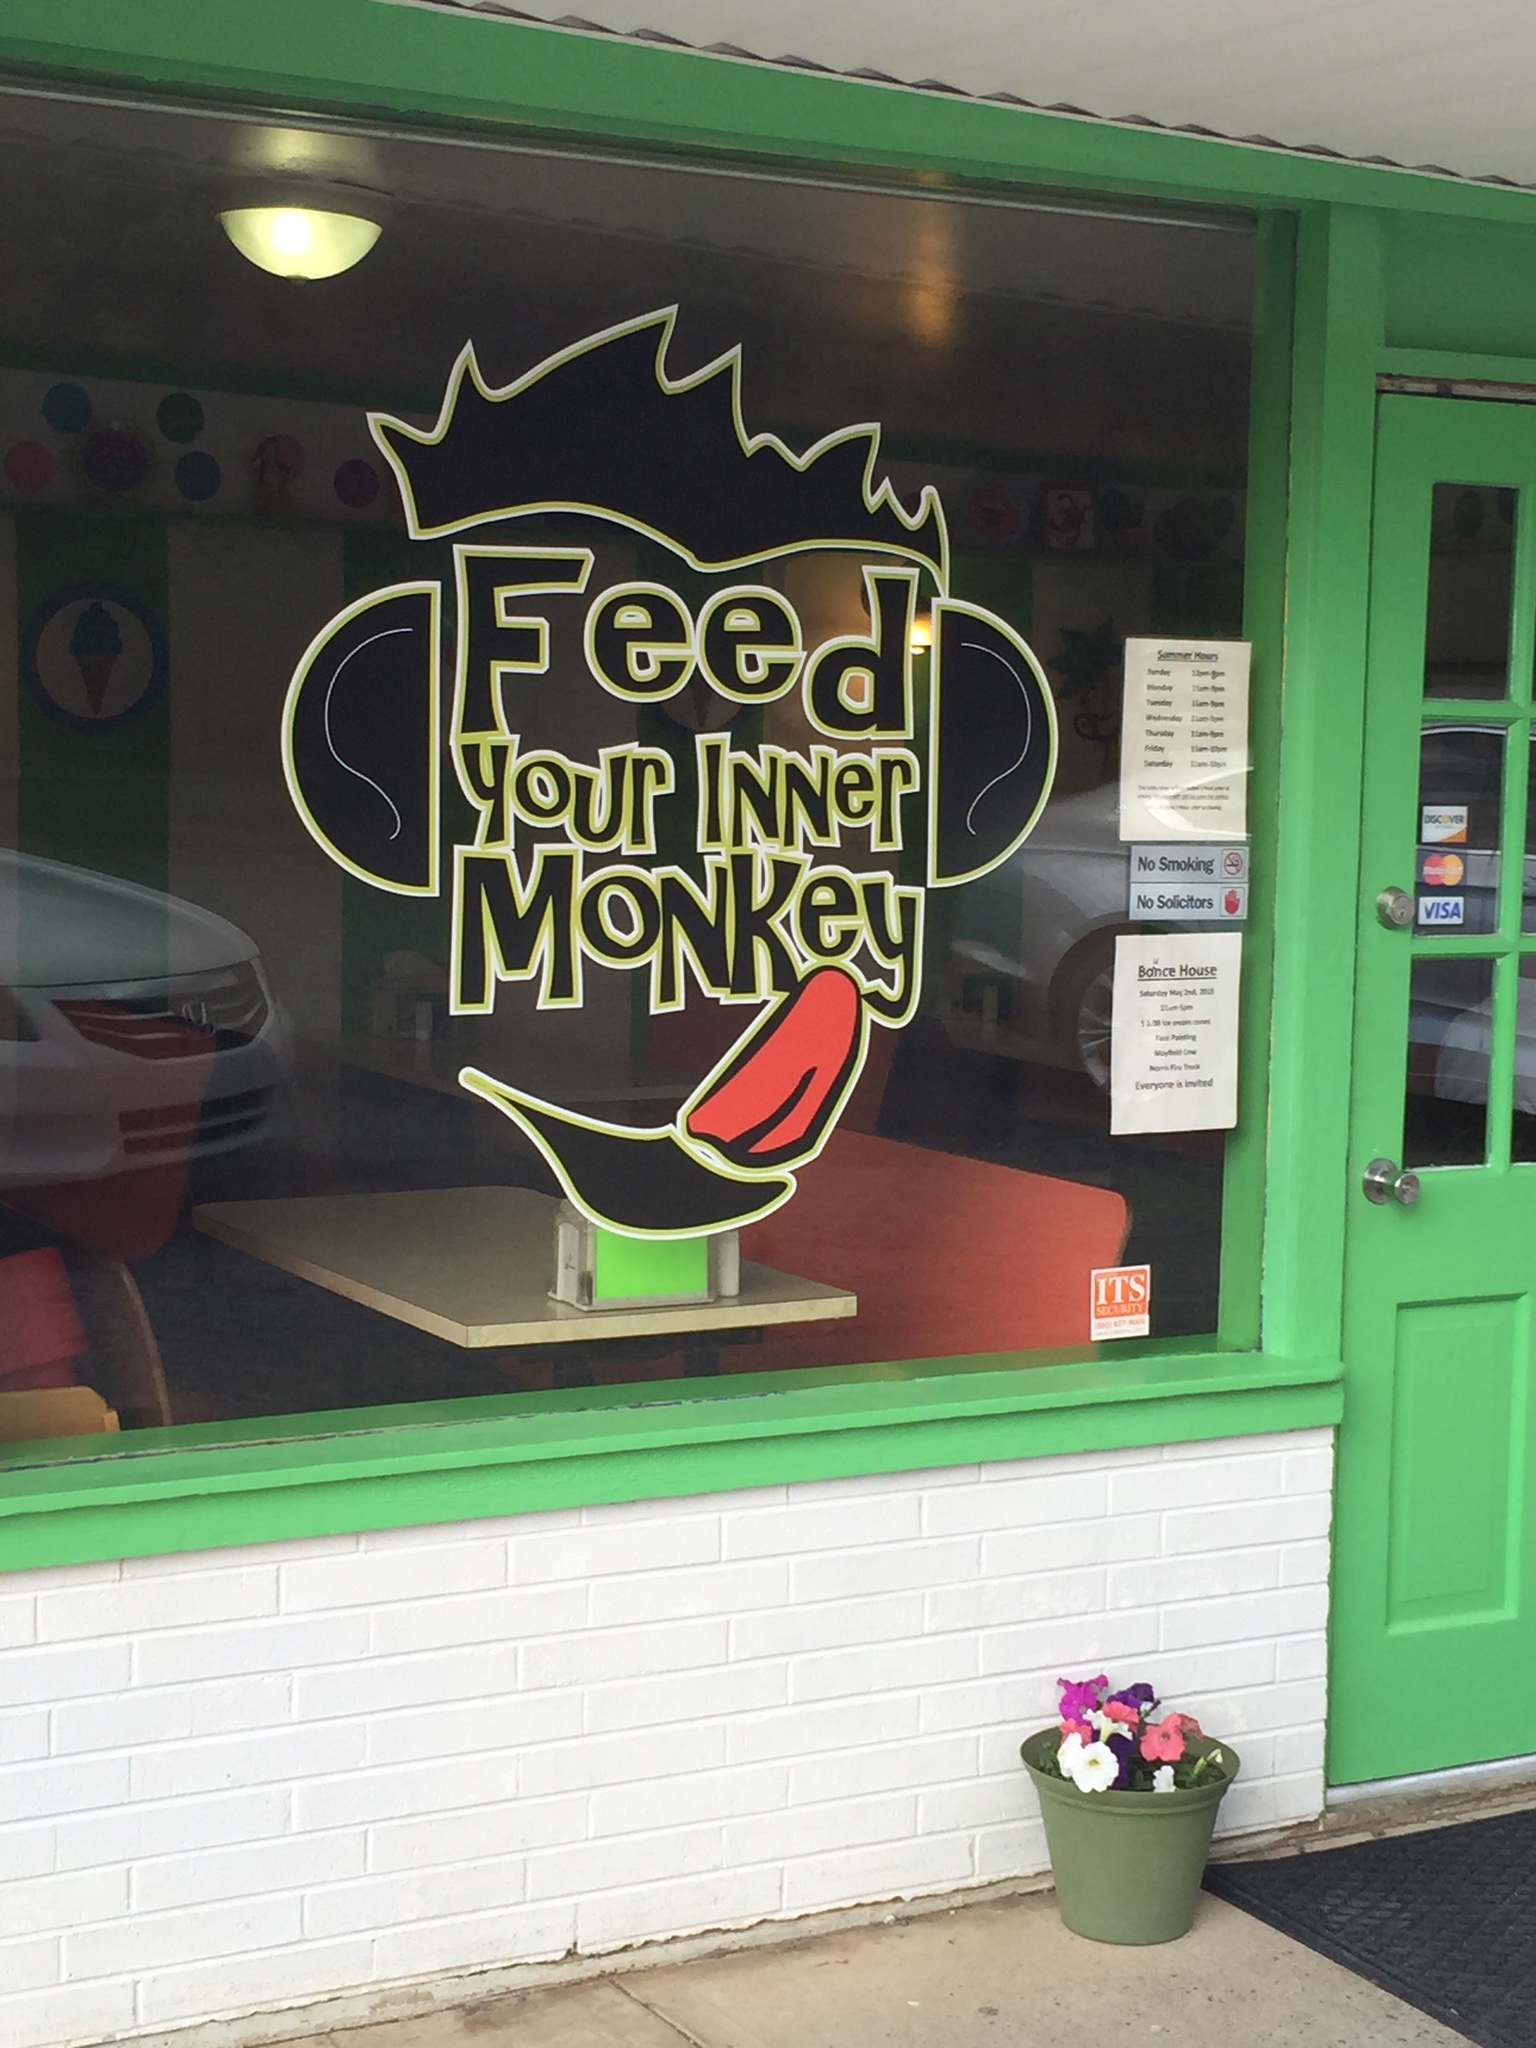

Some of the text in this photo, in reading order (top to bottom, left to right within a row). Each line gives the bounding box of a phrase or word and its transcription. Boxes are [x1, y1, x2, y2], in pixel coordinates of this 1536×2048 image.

[452, 544, 920, 740] Feed
[1157, 650, 1219, 662] Summer Hours
[1148, 668, 1171, 677] Sunday
[1147, 684, 1173, 693] Monday
[1146, 699, 1172, 707] Tuesday
[1146, 714, 1183, 723] Wednesday
[1145, 729, 1174, 738] Thursday
[1144, 744, 1166, 753] Friday
[1144, 760, 1173, 768] Saturday
[1424, 814, 1465, 824] DISCOVER
[1138, 856, 1215, 875] No Smoking
[1137, 895, 1214, 909] No Solicitors
[1423, 902, 1461, 919] VISA
[1179, 964, 1217, 977] House
[1139, 990, 1168, 998] Saturday
[1169, 989, 1183, 997] May
[1171, 1034, 1197, 1042] Painting
[1135, 1078, 1214, 1090] Everyone is invited
[1096, 1274, 1145, 1305] ITS
[1096, 1303, 1143, 1316] SECURITY
